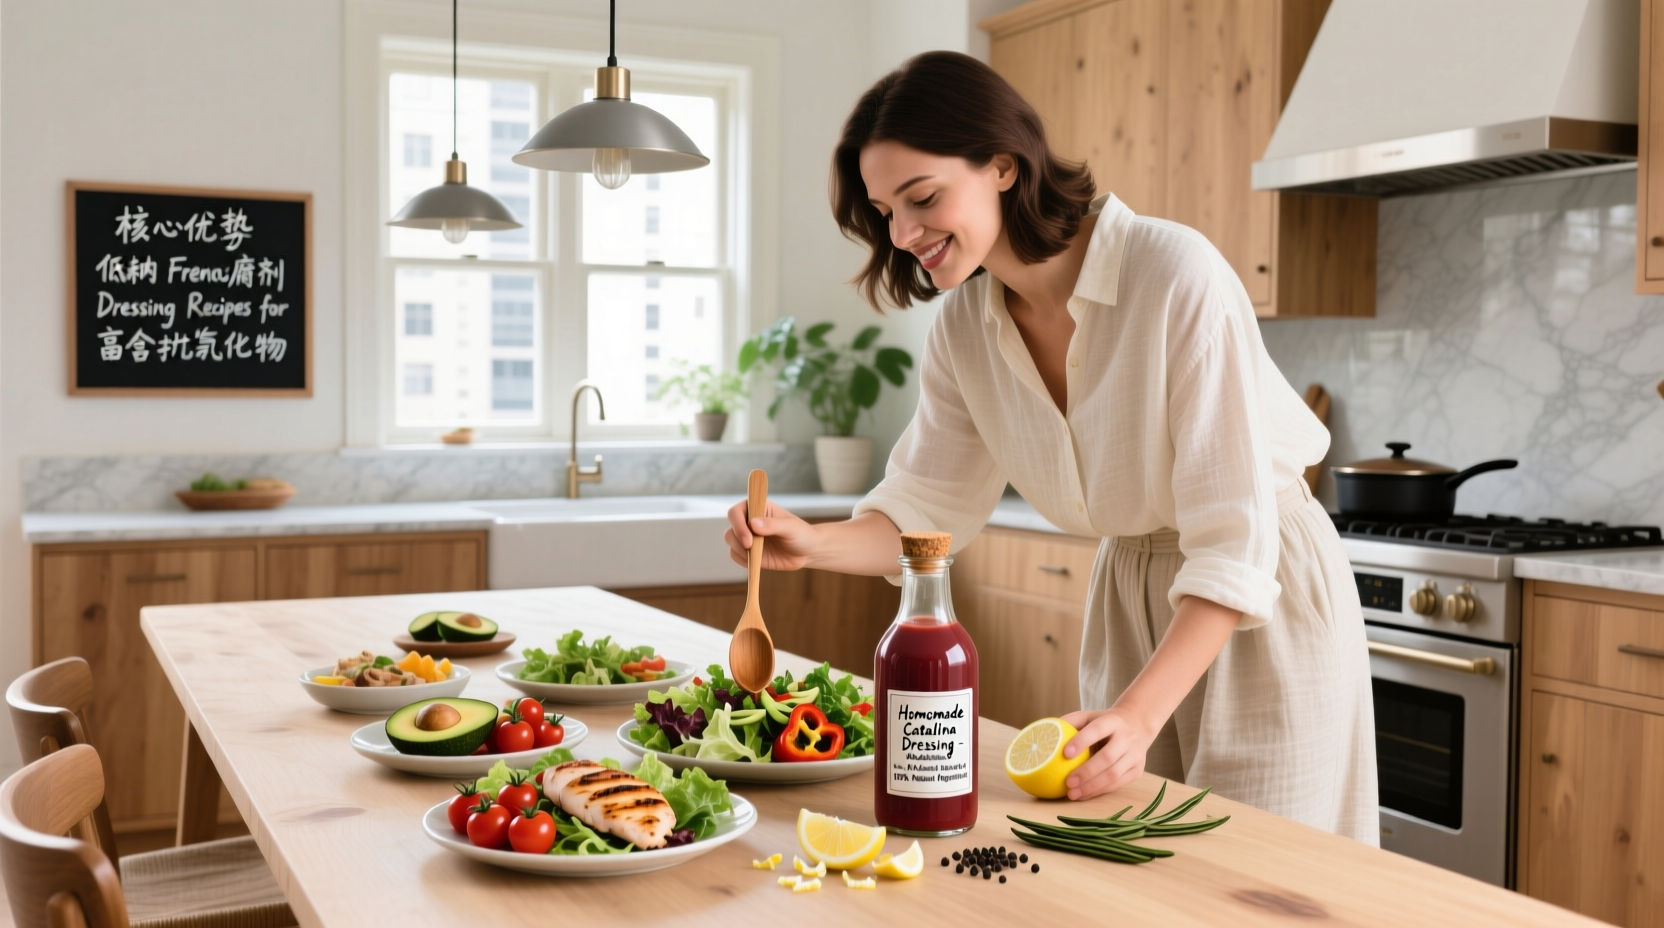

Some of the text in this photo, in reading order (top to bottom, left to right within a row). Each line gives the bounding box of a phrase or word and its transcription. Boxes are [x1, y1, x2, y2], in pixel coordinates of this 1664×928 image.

[115, 205, 254, 251] 核心优势
[97, 290, 289, 329] Dressing Recipes for
[903, 722, 956, 736] Catalina
[902, 736, 954, 759] Dressing
